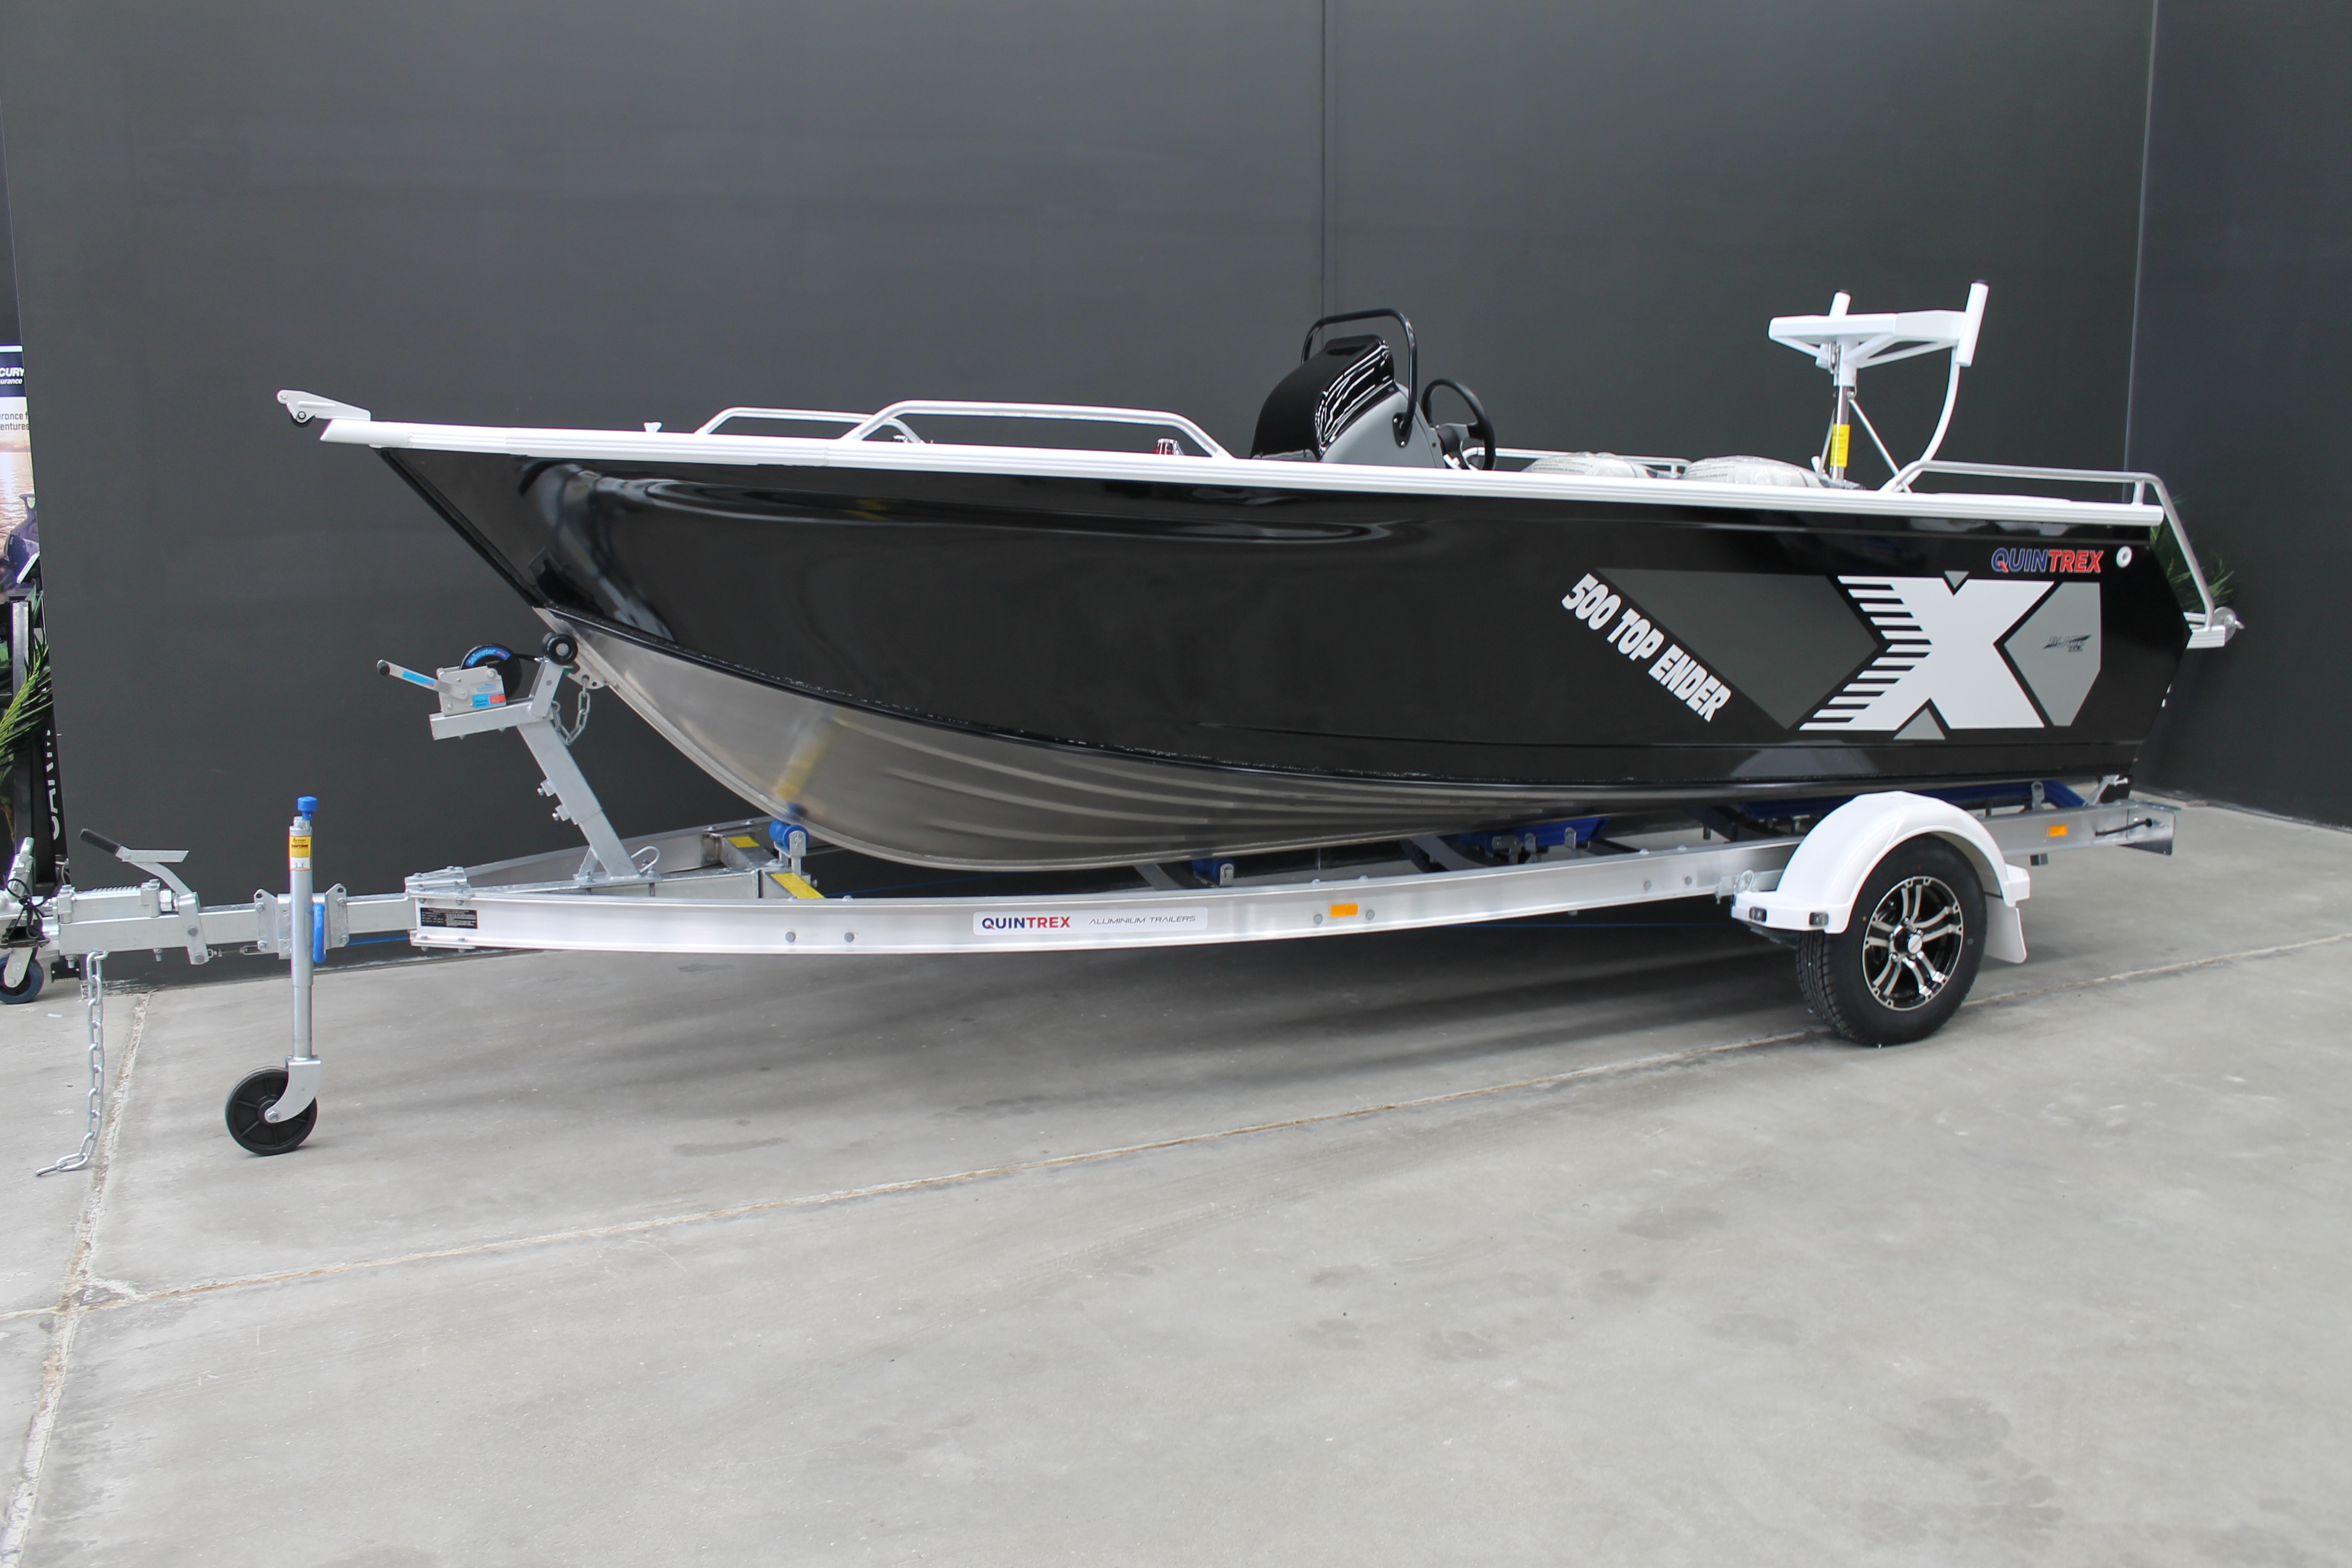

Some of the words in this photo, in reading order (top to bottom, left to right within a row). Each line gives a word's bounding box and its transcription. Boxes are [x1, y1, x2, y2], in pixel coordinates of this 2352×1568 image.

[1991, 547, 2104, 573] QUINTREX
[1561, 573, 1621, 630] 500
[1607, 607, 1665, 661] TOP
[1648, 644, 1732, 723] ENDER
[982, 916, 1071, 929] QUINTREX
[1089, 917, 1146, 925] ALUMINIUM
[1149, 915, 1196, 923] TRAILERS
